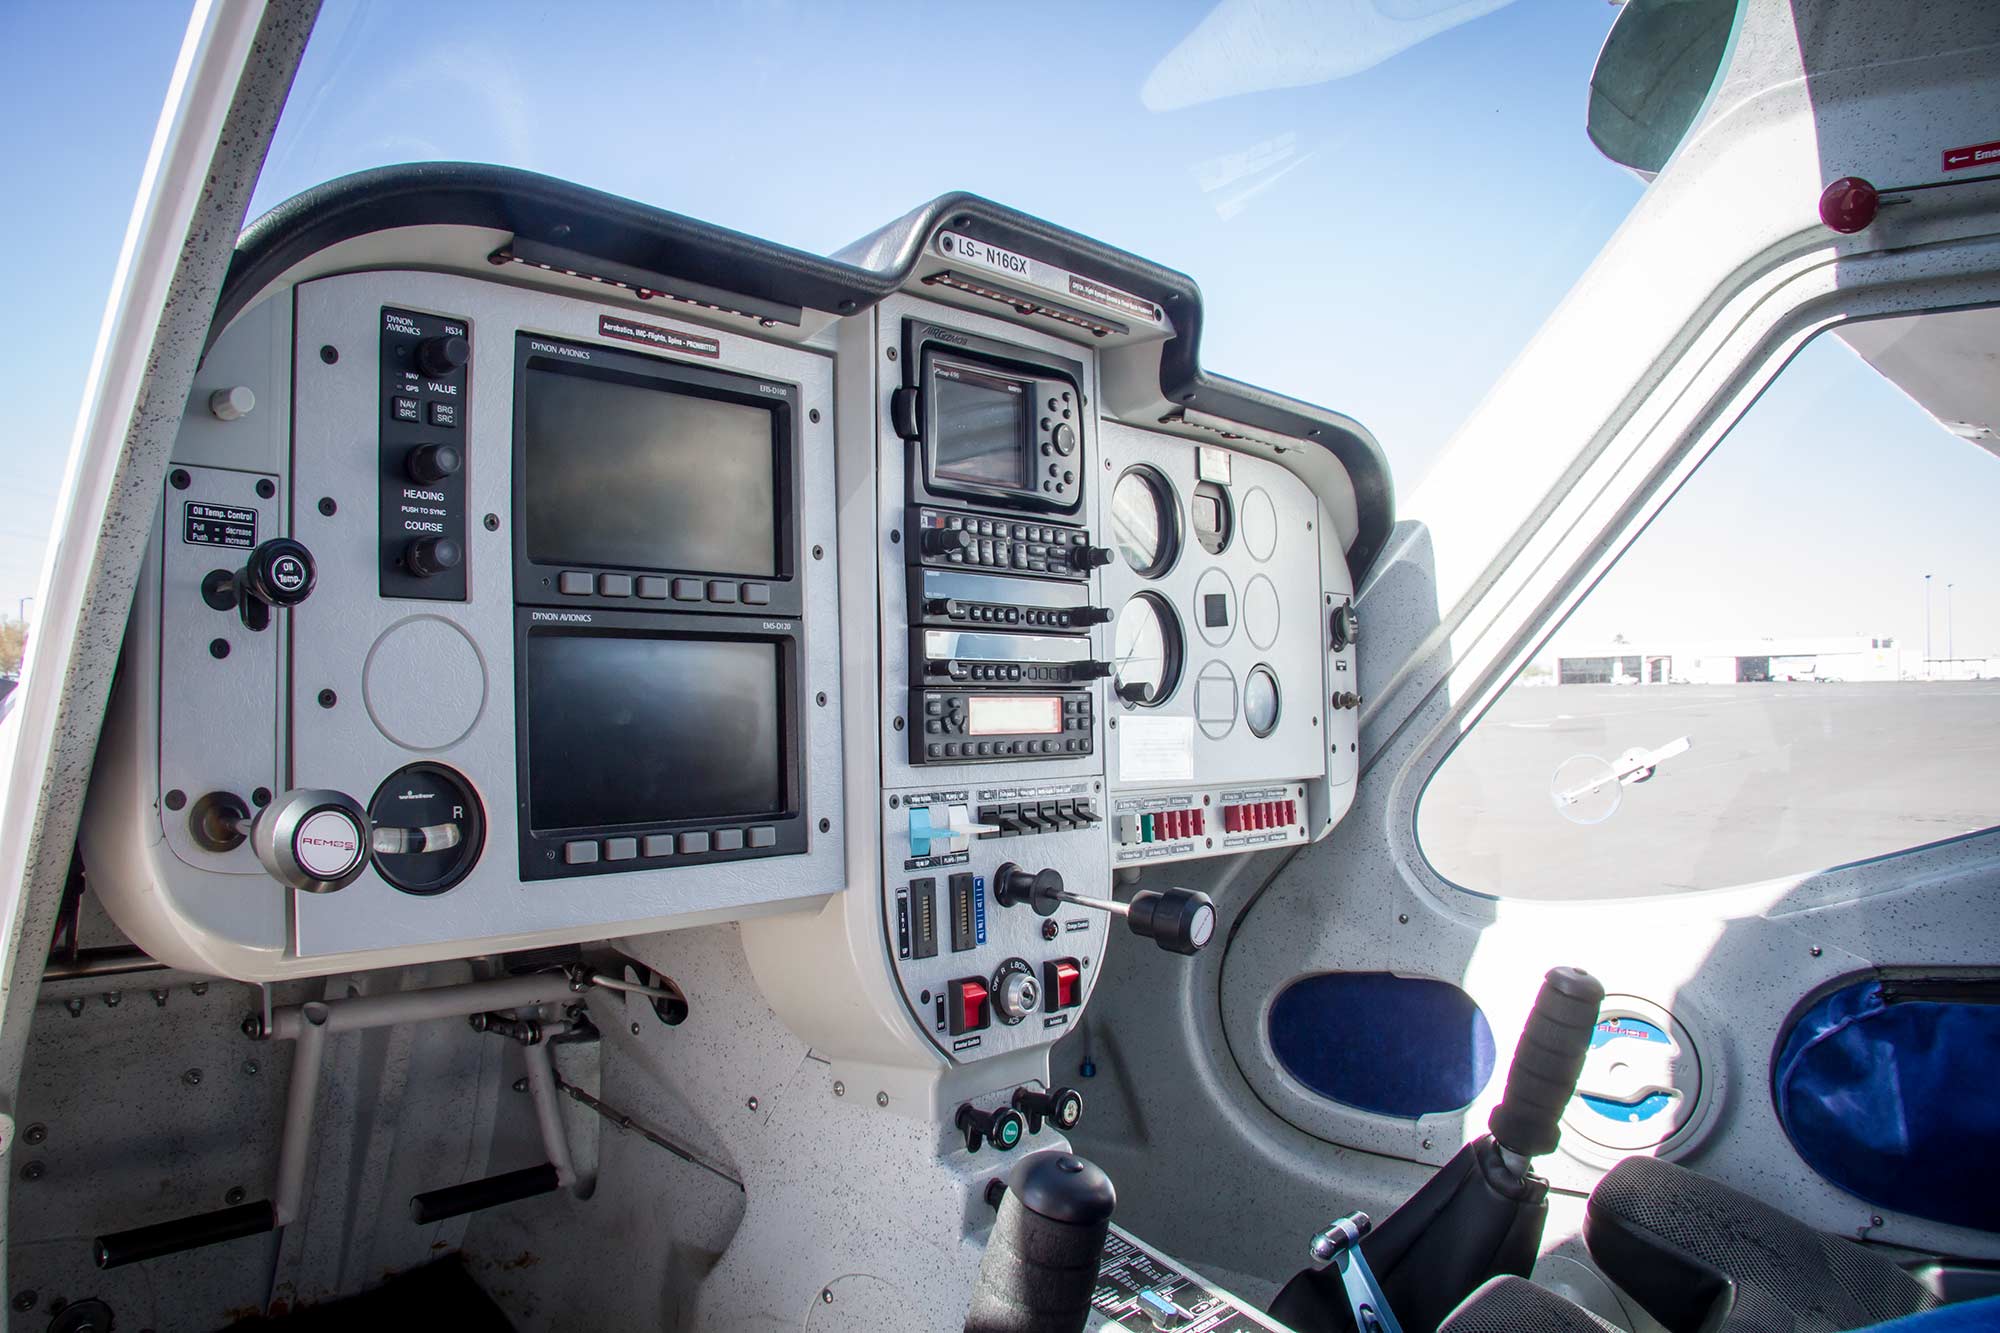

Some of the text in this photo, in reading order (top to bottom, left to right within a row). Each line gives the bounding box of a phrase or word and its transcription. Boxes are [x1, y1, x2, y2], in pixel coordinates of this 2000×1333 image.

[986, 248, 1027, 274] N16GX
[386, 314, 414, 327] DYNON
[386, 323, 421, 336] AVIONICS
[445, 325, 463, 336] HS34
[531, 341, 591, 360] DYNON AVIONICS
[405, 372, 419, 381] NAV
[405, 384, 419, 393] GPS
[428, 382, 457, 395] VALUE
[400, 399, 417, 410] NAV
[437, 405, 453, 415] BRG
[400, 409, 417, 419] SRC
[437, 414, 453, 424] SRC
[403, 489, 444, 502] HEADING
[193, 506, 253, 521] Oil Temp. Control
[401, 506, 447, 517] PUSH TO SYNC
[193, 523, 205, 532] Pull
[225, 526, 252, 537] decrease
[405, 520, 443, 532] COURSE
[192, 532, 209, 542] Push
[225, 535, 250, 546] increase
[283, 562, 293, 571] Oil
[532, 611, 592, 623] DYNON AVIONICS
[763, 622, 792, 631] EMS-D120
[398, 790, 436, 800] winter
[453, 805, 464, 819] R
[302, 837, 355, 850] REMOS
[1015, 961, 1028, 974] BOTH
[1597, 1025, 1649, 1039] REMOS
